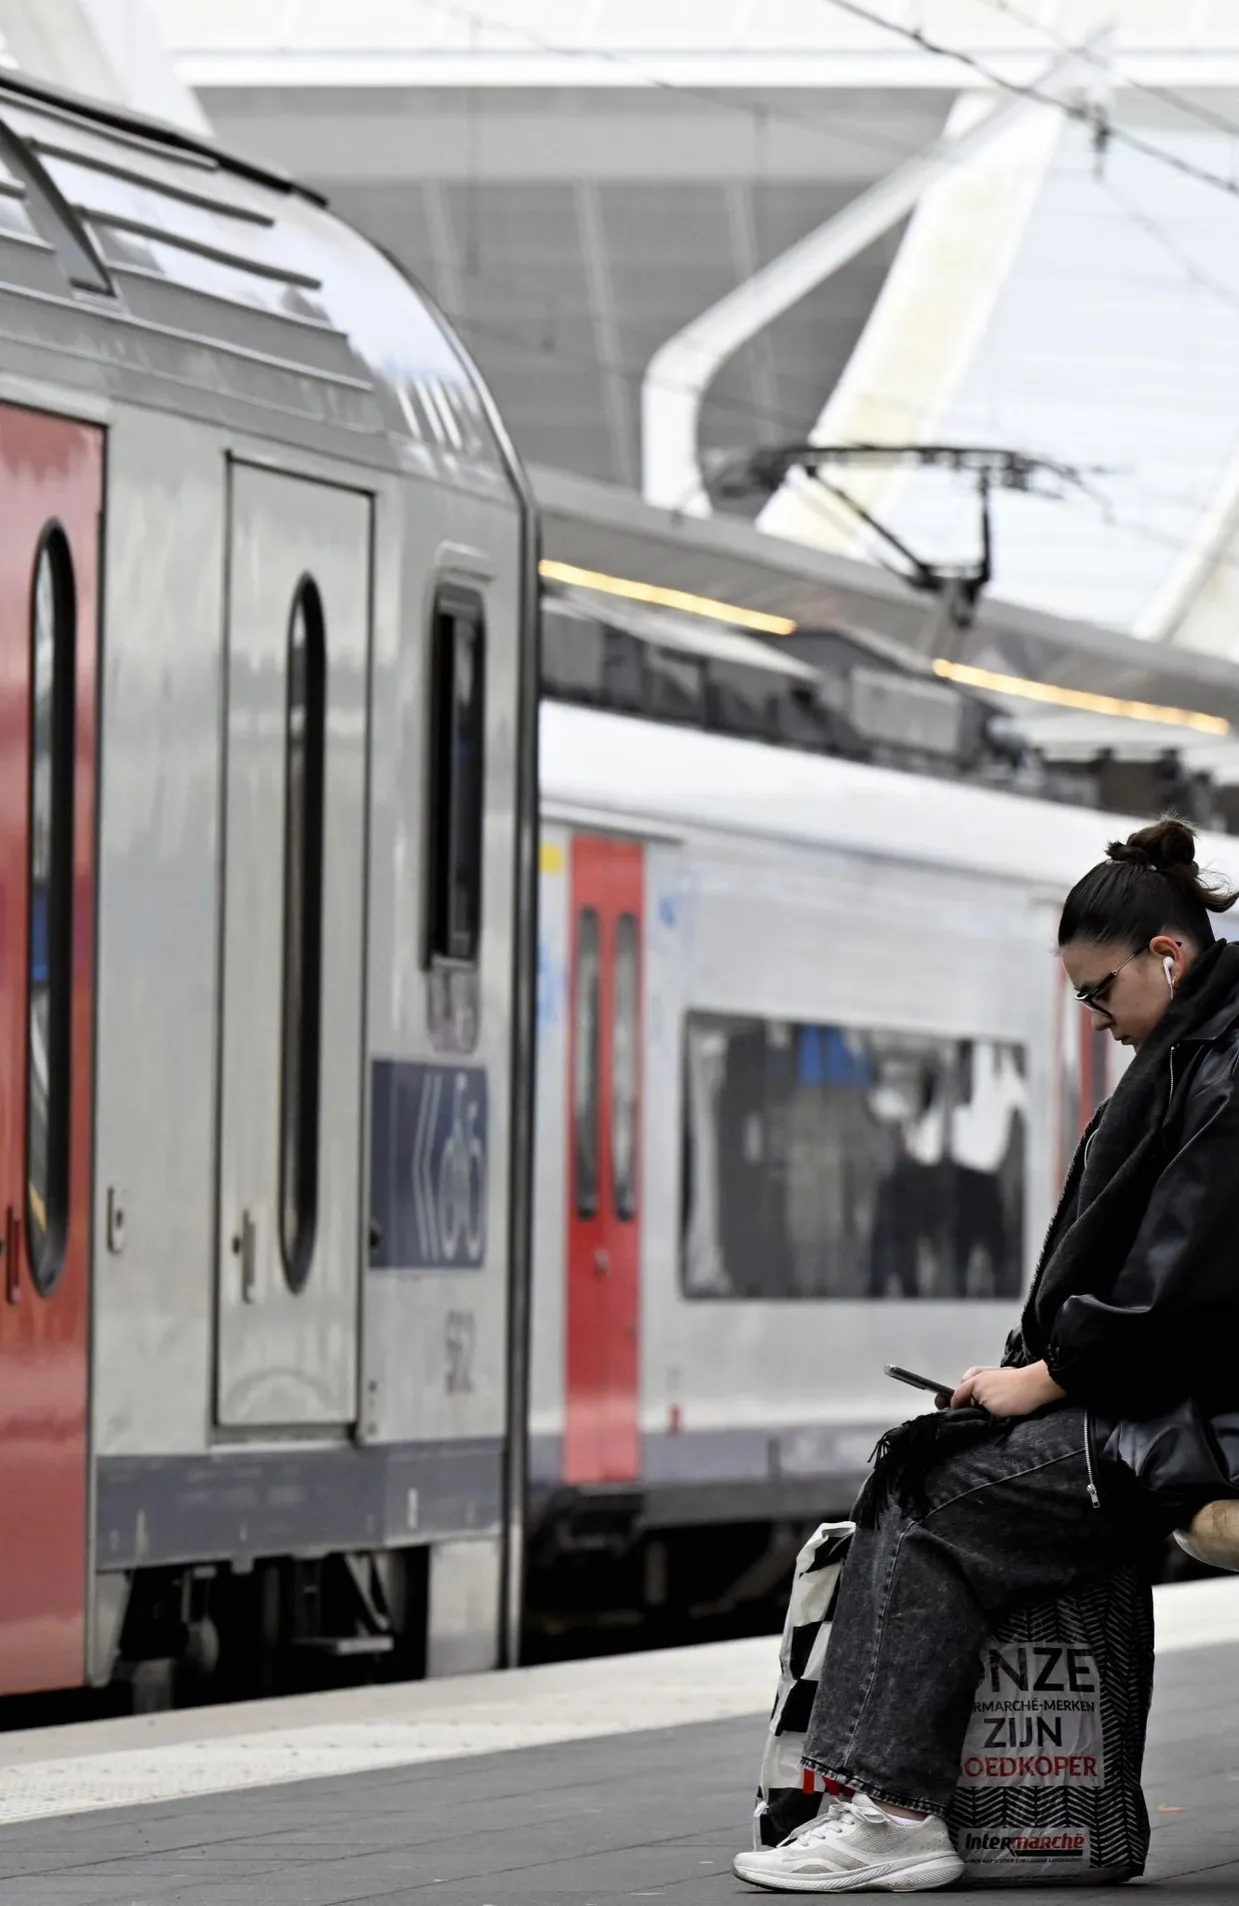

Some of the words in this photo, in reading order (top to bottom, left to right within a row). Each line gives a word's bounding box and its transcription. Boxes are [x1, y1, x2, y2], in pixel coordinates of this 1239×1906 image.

[981, 1647, 1095, 1693] NZE
[973, 1697, 1095, 1713] RMARCHÉ-MERKEN
[983, 1716, 1063, 1749] ZIJN
[963, 1755, 1098, 1778] OEDKOPER
